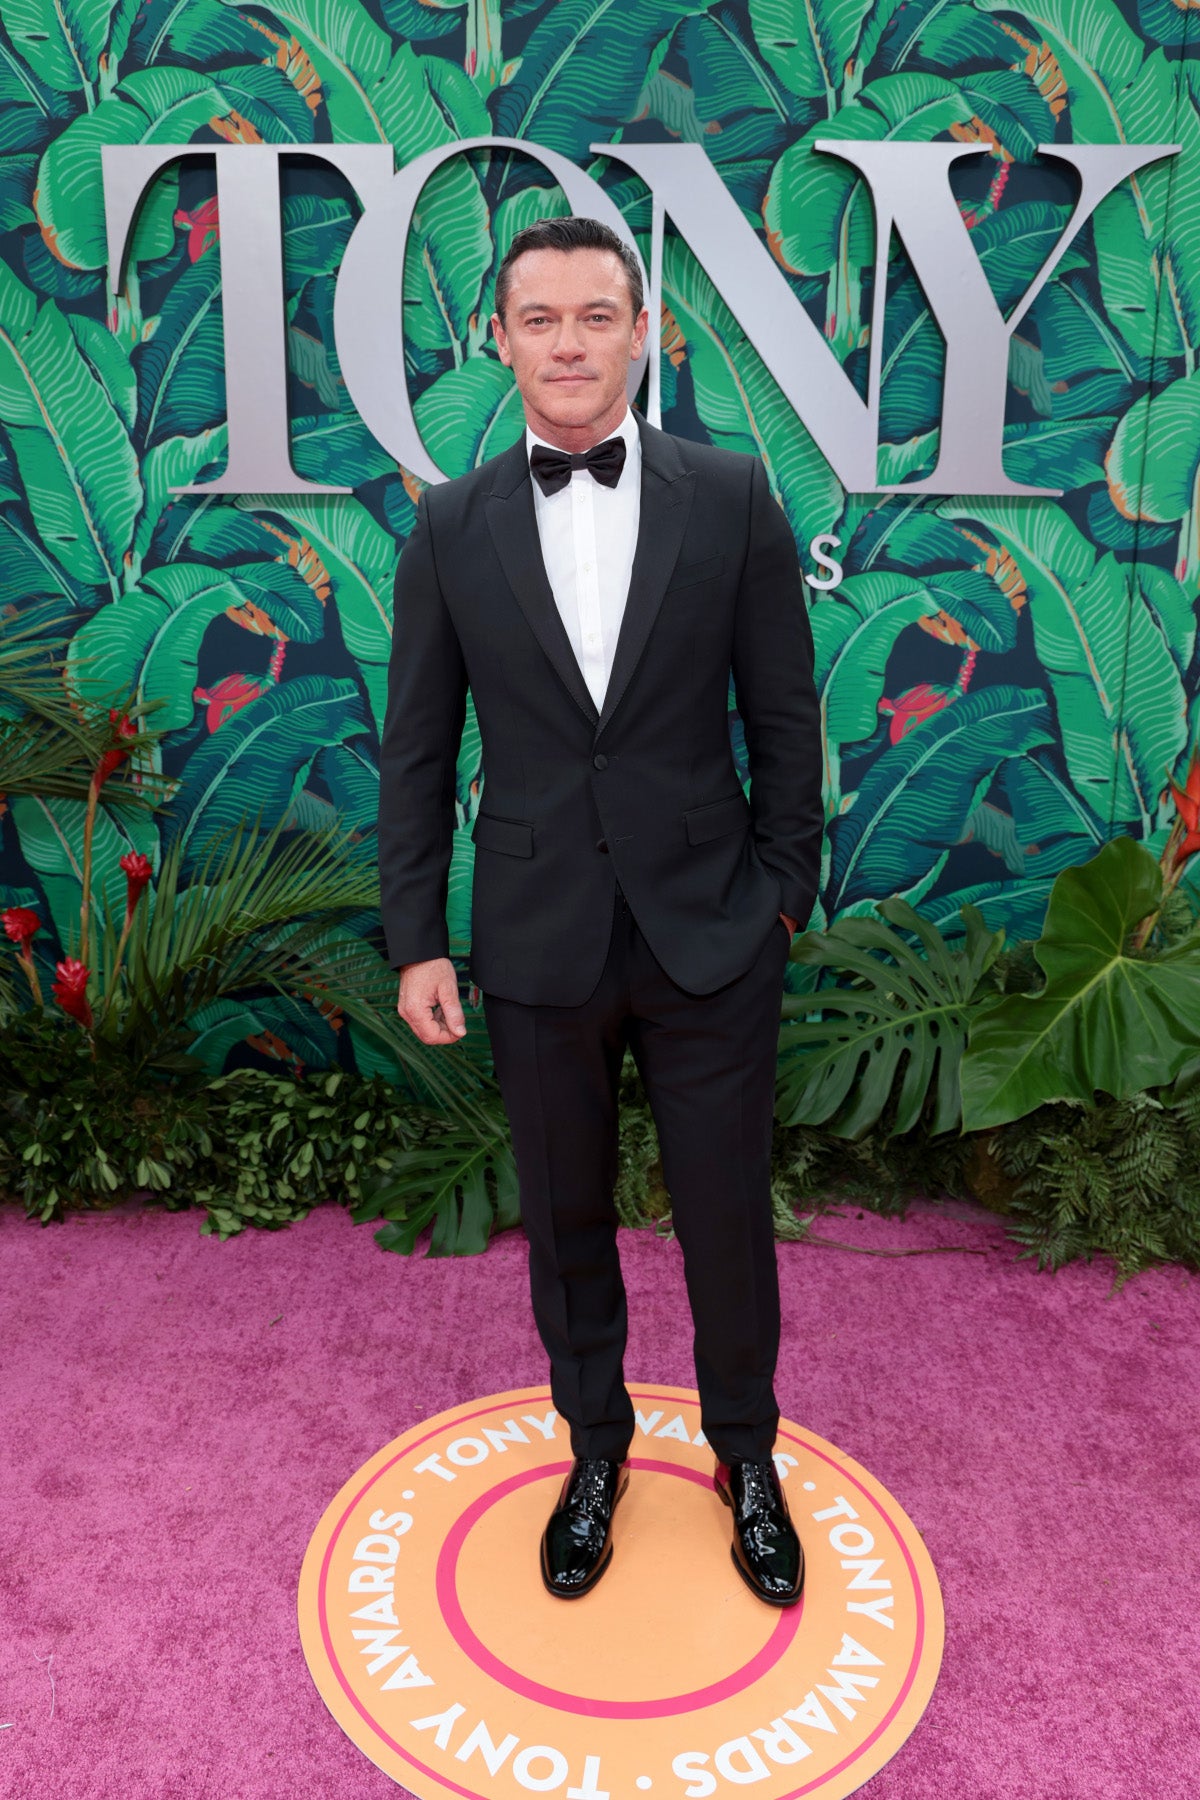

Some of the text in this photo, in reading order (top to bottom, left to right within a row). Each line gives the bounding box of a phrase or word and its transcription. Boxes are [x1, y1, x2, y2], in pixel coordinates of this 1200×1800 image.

[100, 137, 1183, 498] TONY
[412, 1409, 558, 1483] TONY
[348, 1508, 611, 1800] TONY AWARDS
[671, 1496, 895, 1798] TONY AWARDS
